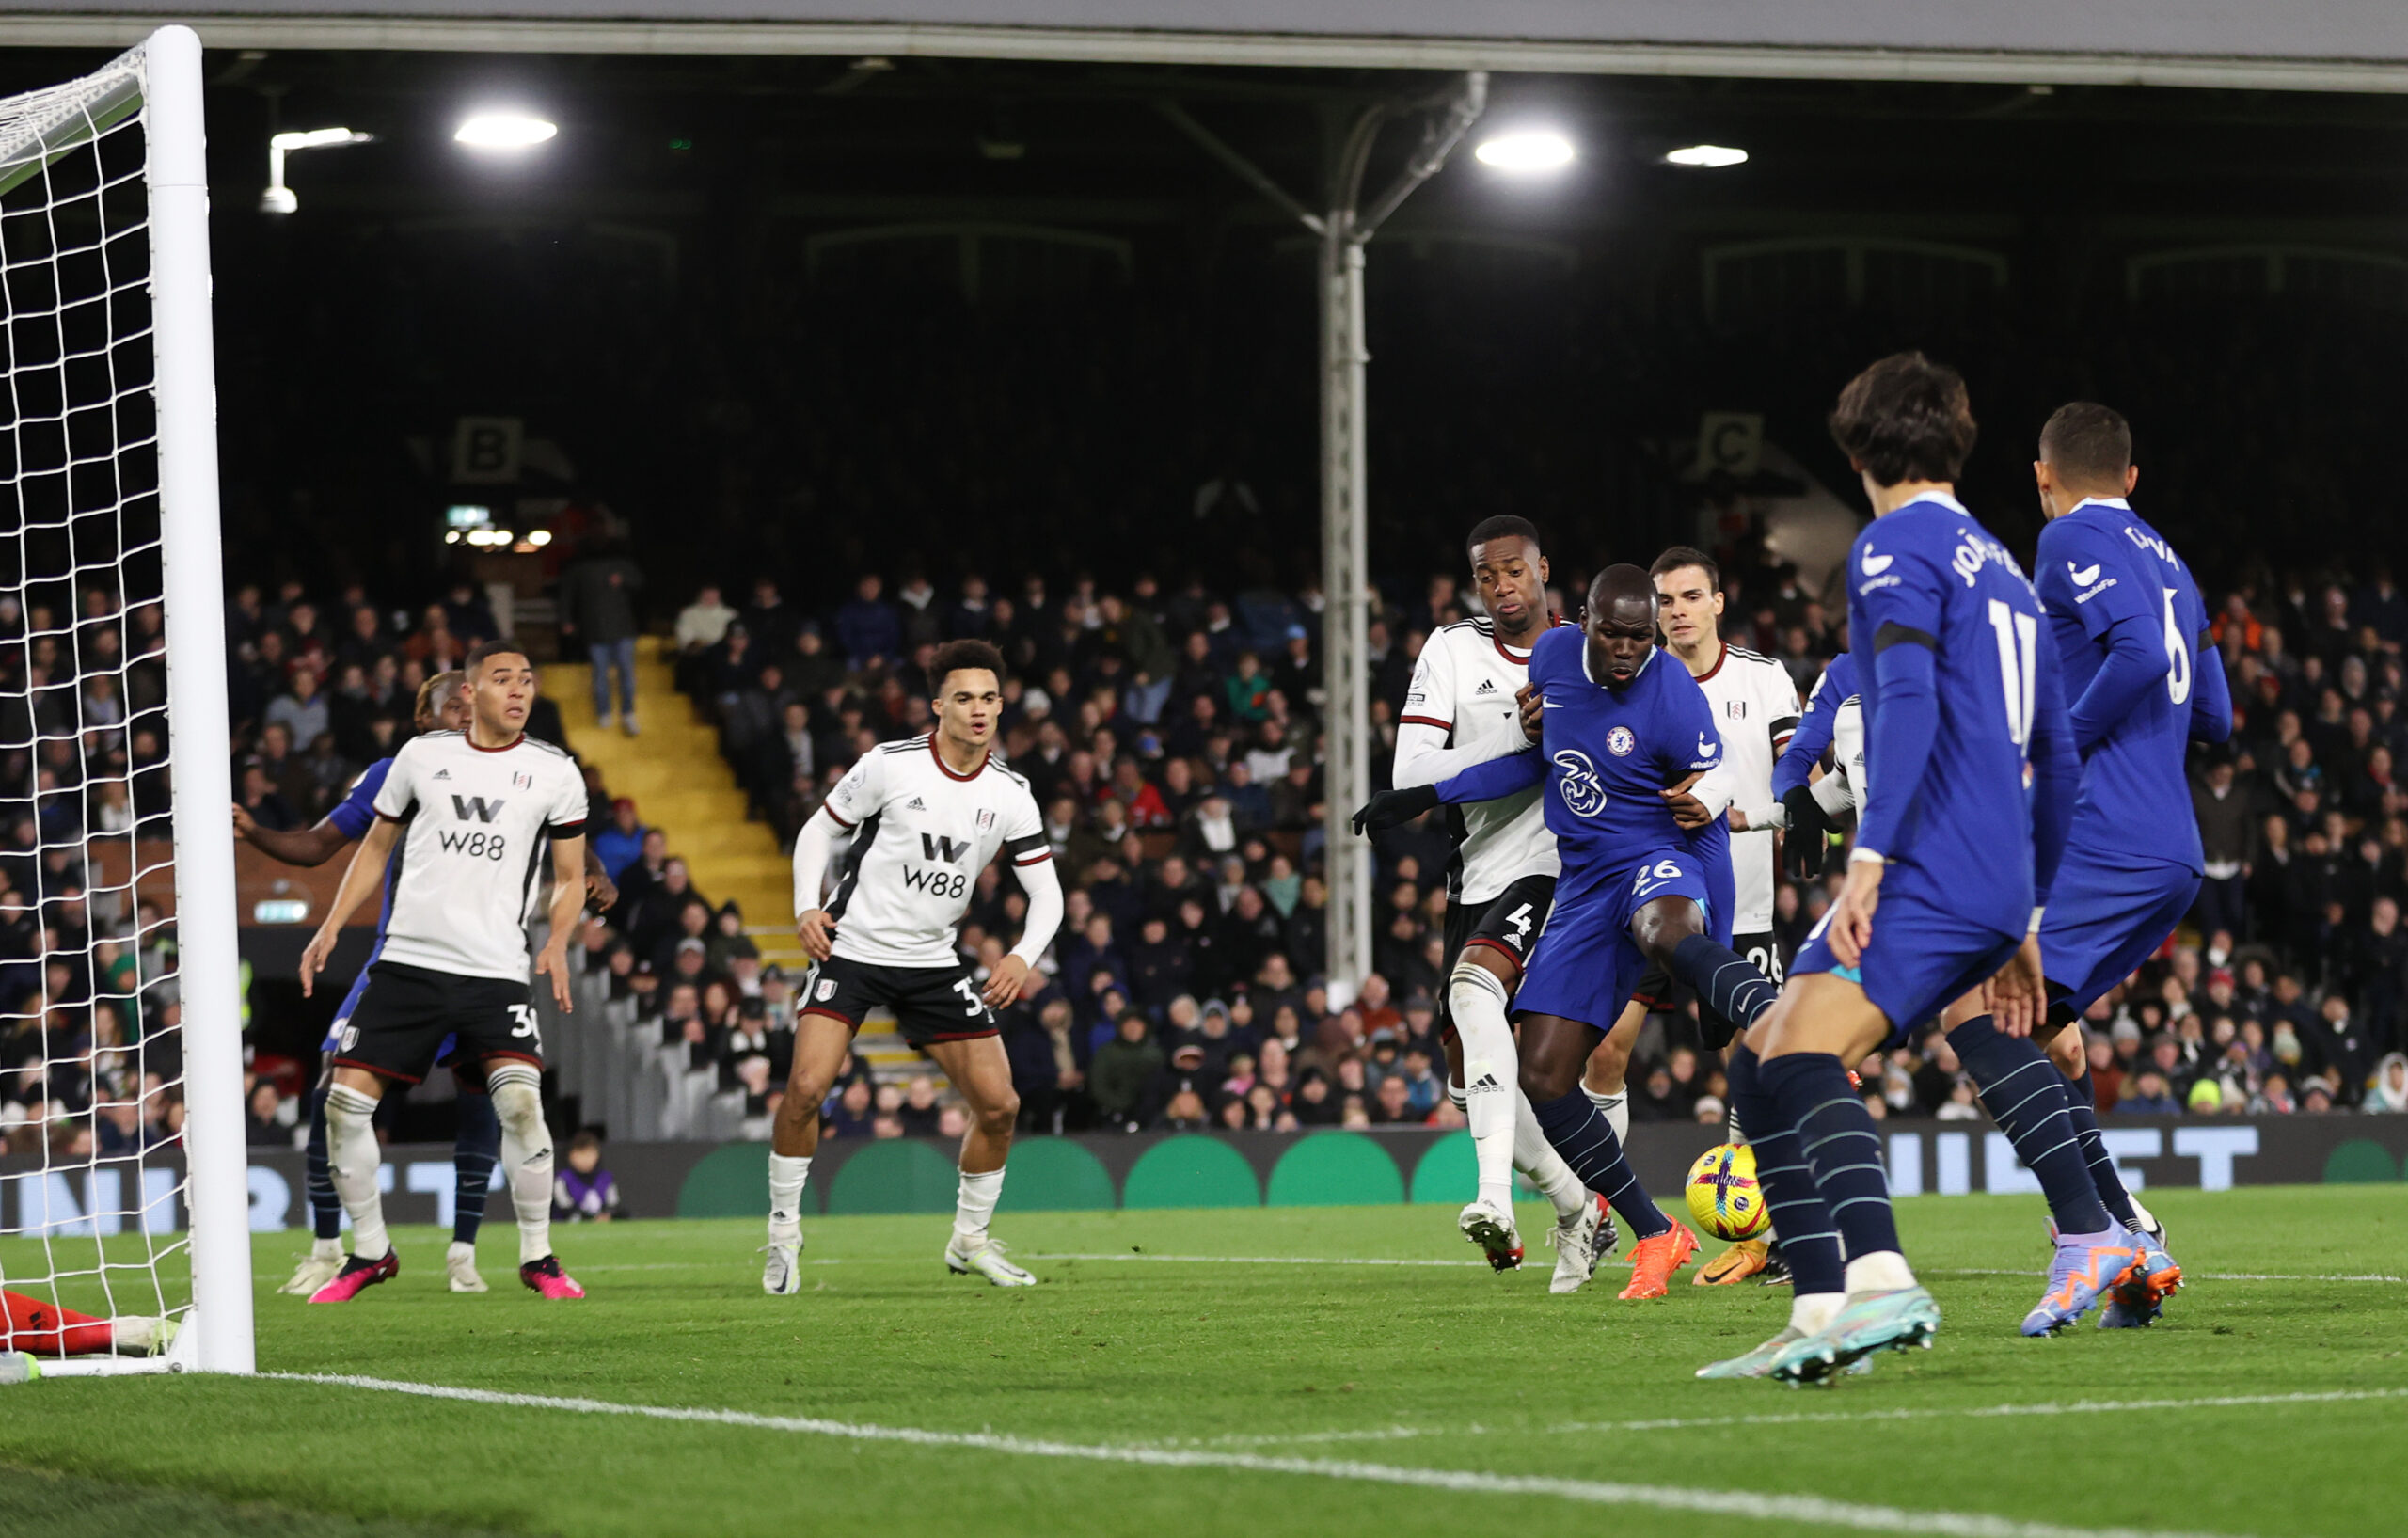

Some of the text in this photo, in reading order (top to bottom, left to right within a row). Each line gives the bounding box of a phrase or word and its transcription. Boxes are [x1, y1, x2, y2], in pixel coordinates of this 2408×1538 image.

[470, 428, 505, 469] B
[1712, 420, 1750, 467] C
[2163, 587, 2192, 706] 6
[1988, 598, 2037, 759] 11
[439, 830, 505, 861] W88
[903, 864, 966, 898] W88
[1631, 859, 1683, 896] 26
[1505, 902, 1534, 936] 4
